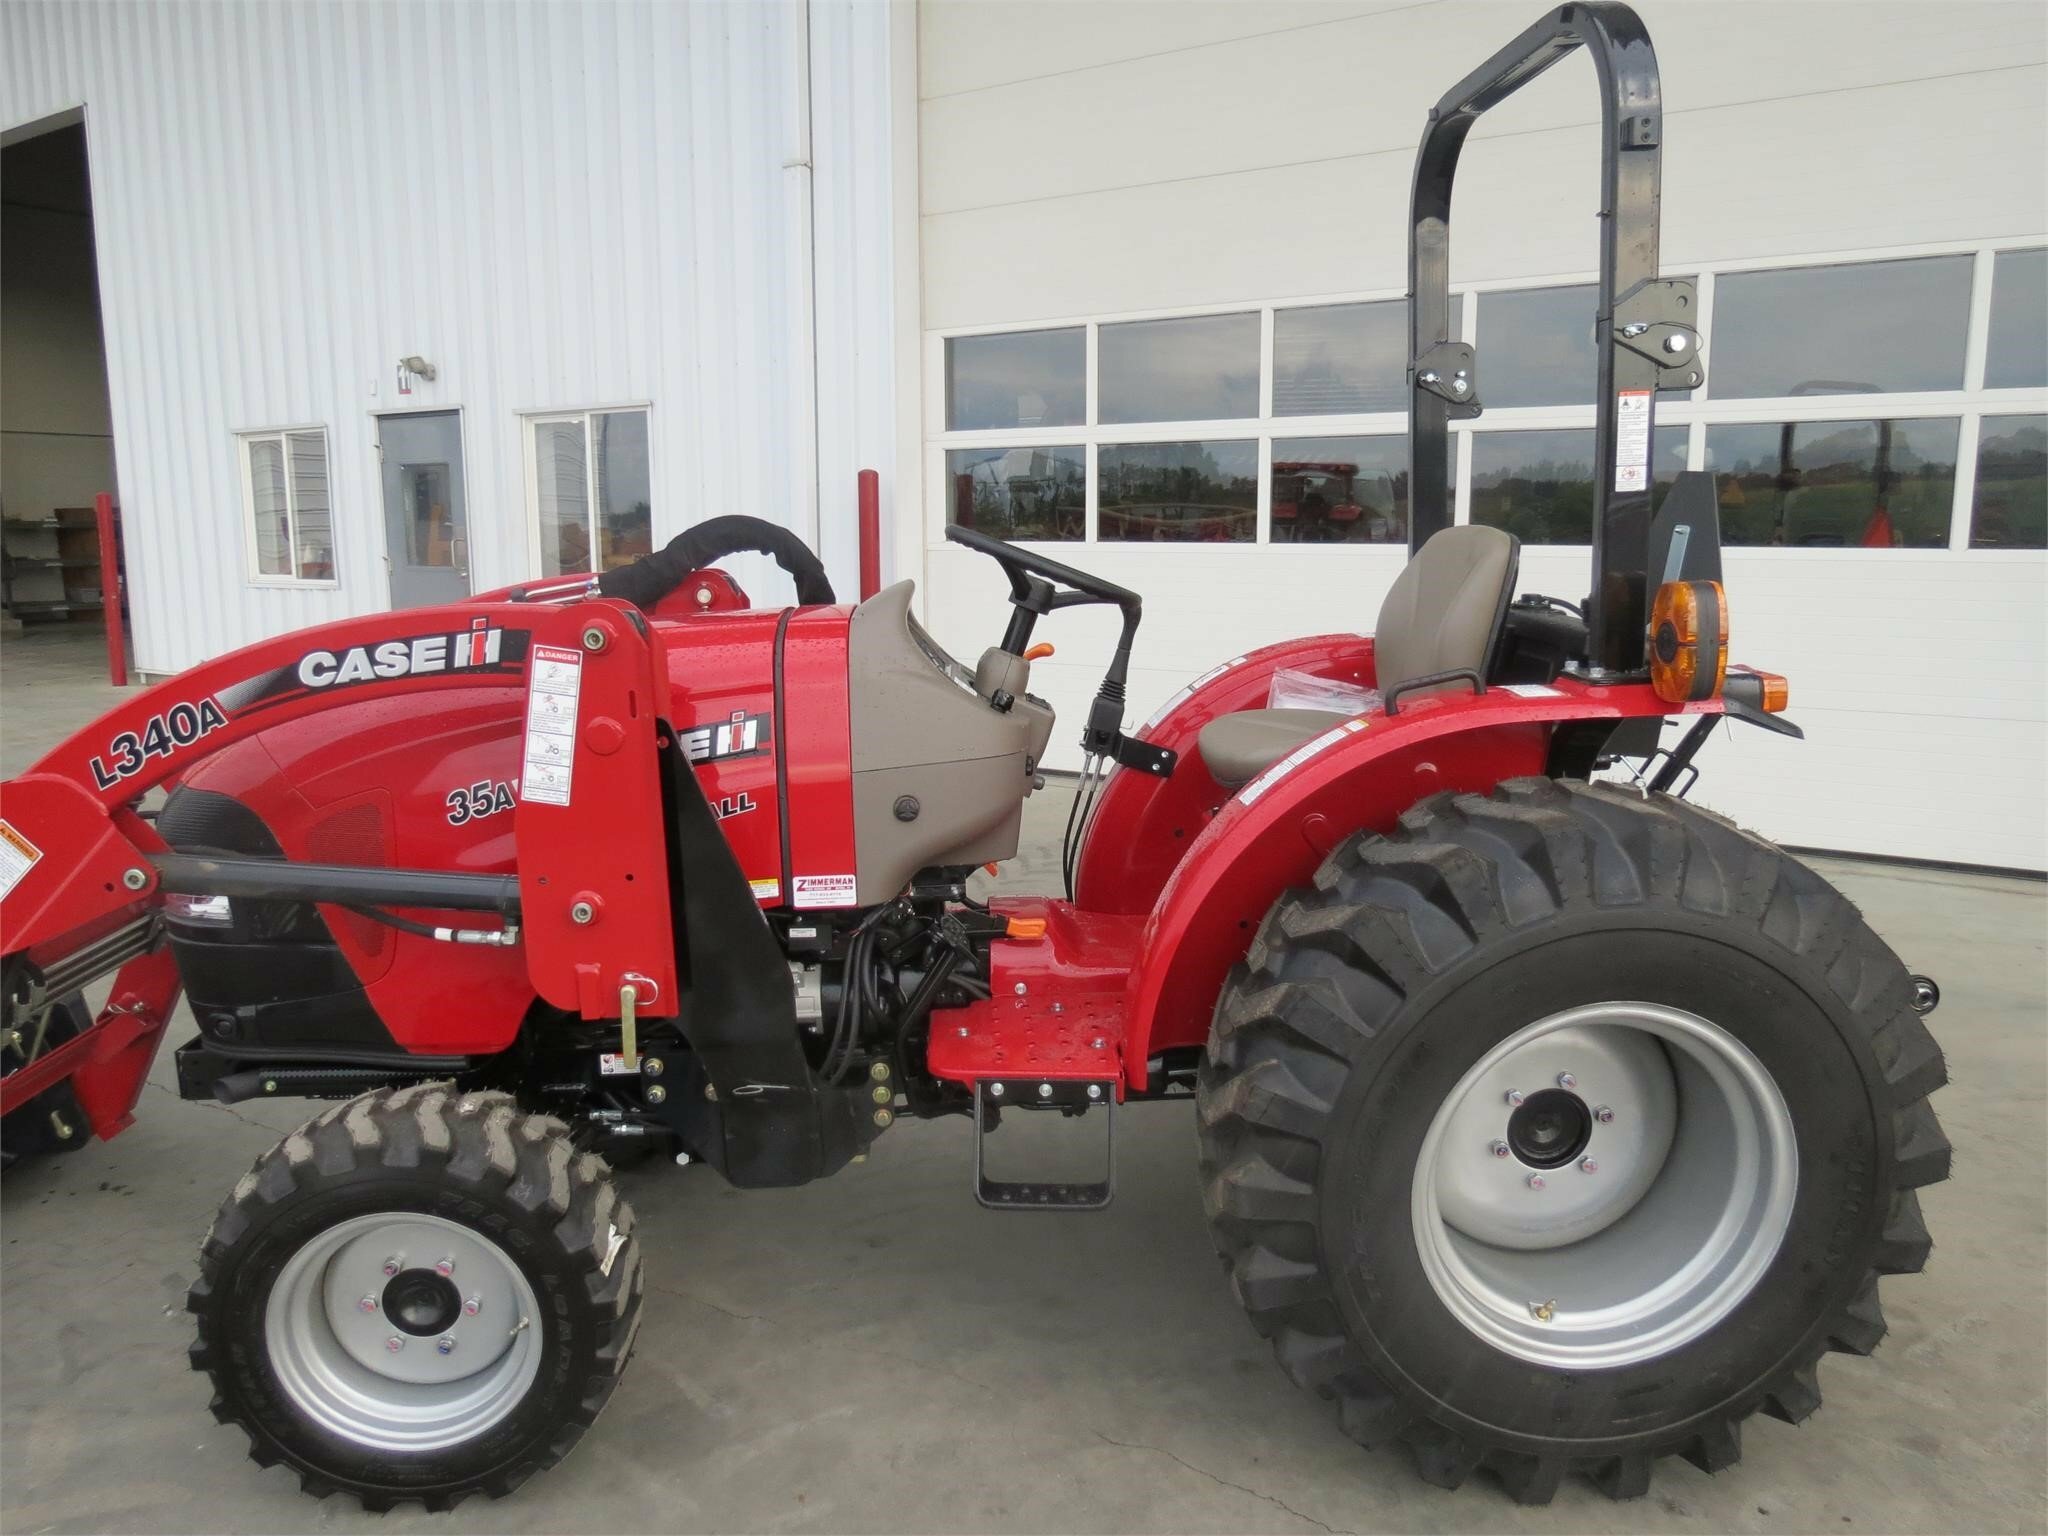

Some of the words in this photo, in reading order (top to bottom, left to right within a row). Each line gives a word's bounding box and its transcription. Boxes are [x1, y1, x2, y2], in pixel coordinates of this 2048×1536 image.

[298, 636, 448, 688] CASE
[545, 650, 580, 662] DANGER
[89, 697, 229, 791] L340A
[446, 780, 516, 826] 35A
[796, 877, 854, 892] ZIMMERMAN
